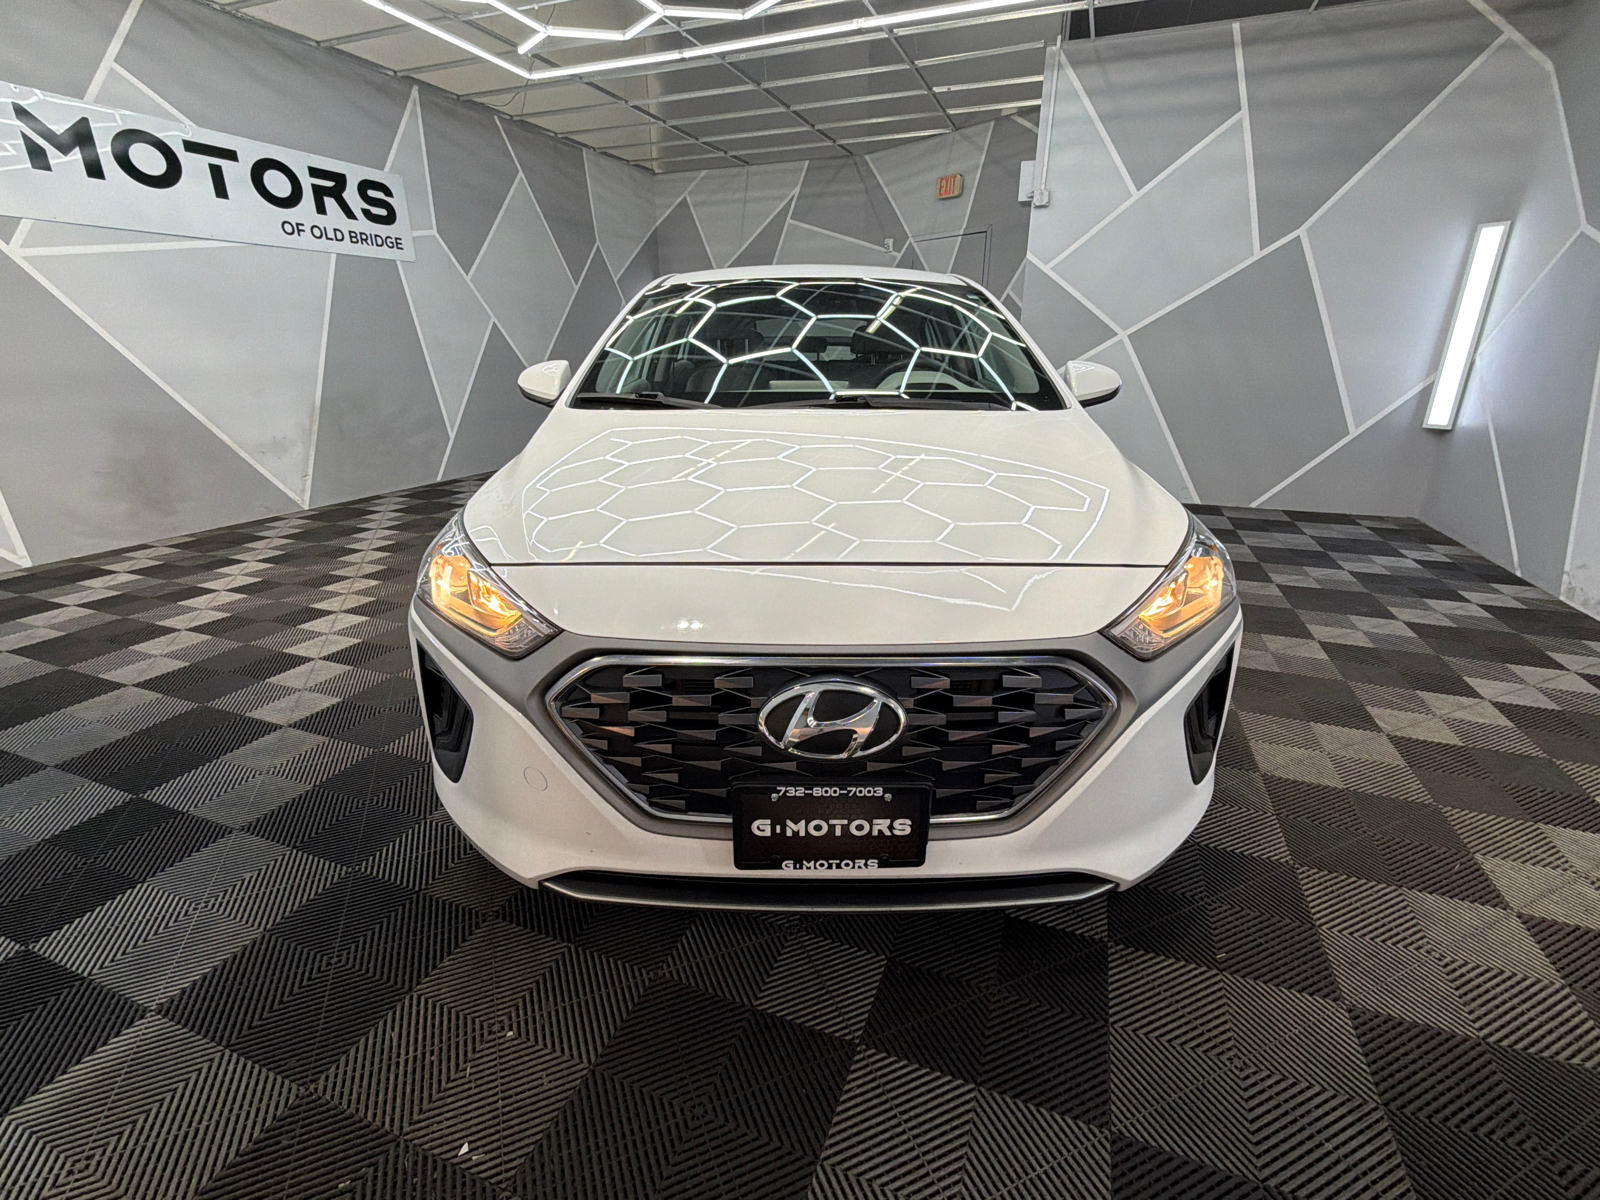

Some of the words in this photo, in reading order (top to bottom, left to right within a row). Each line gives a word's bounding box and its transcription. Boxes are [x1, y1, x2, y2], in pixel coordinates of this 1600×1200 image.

[11, 101, 397, 226] MOTORS
[939, 174, 957, 198] EXIT
[281, 220, 305, 237] OF
[310, 224, 345, 242] OLD
[348, 230, 404, 250] BRIDGE
[776, 786, 883, 797] 732-800-7003
